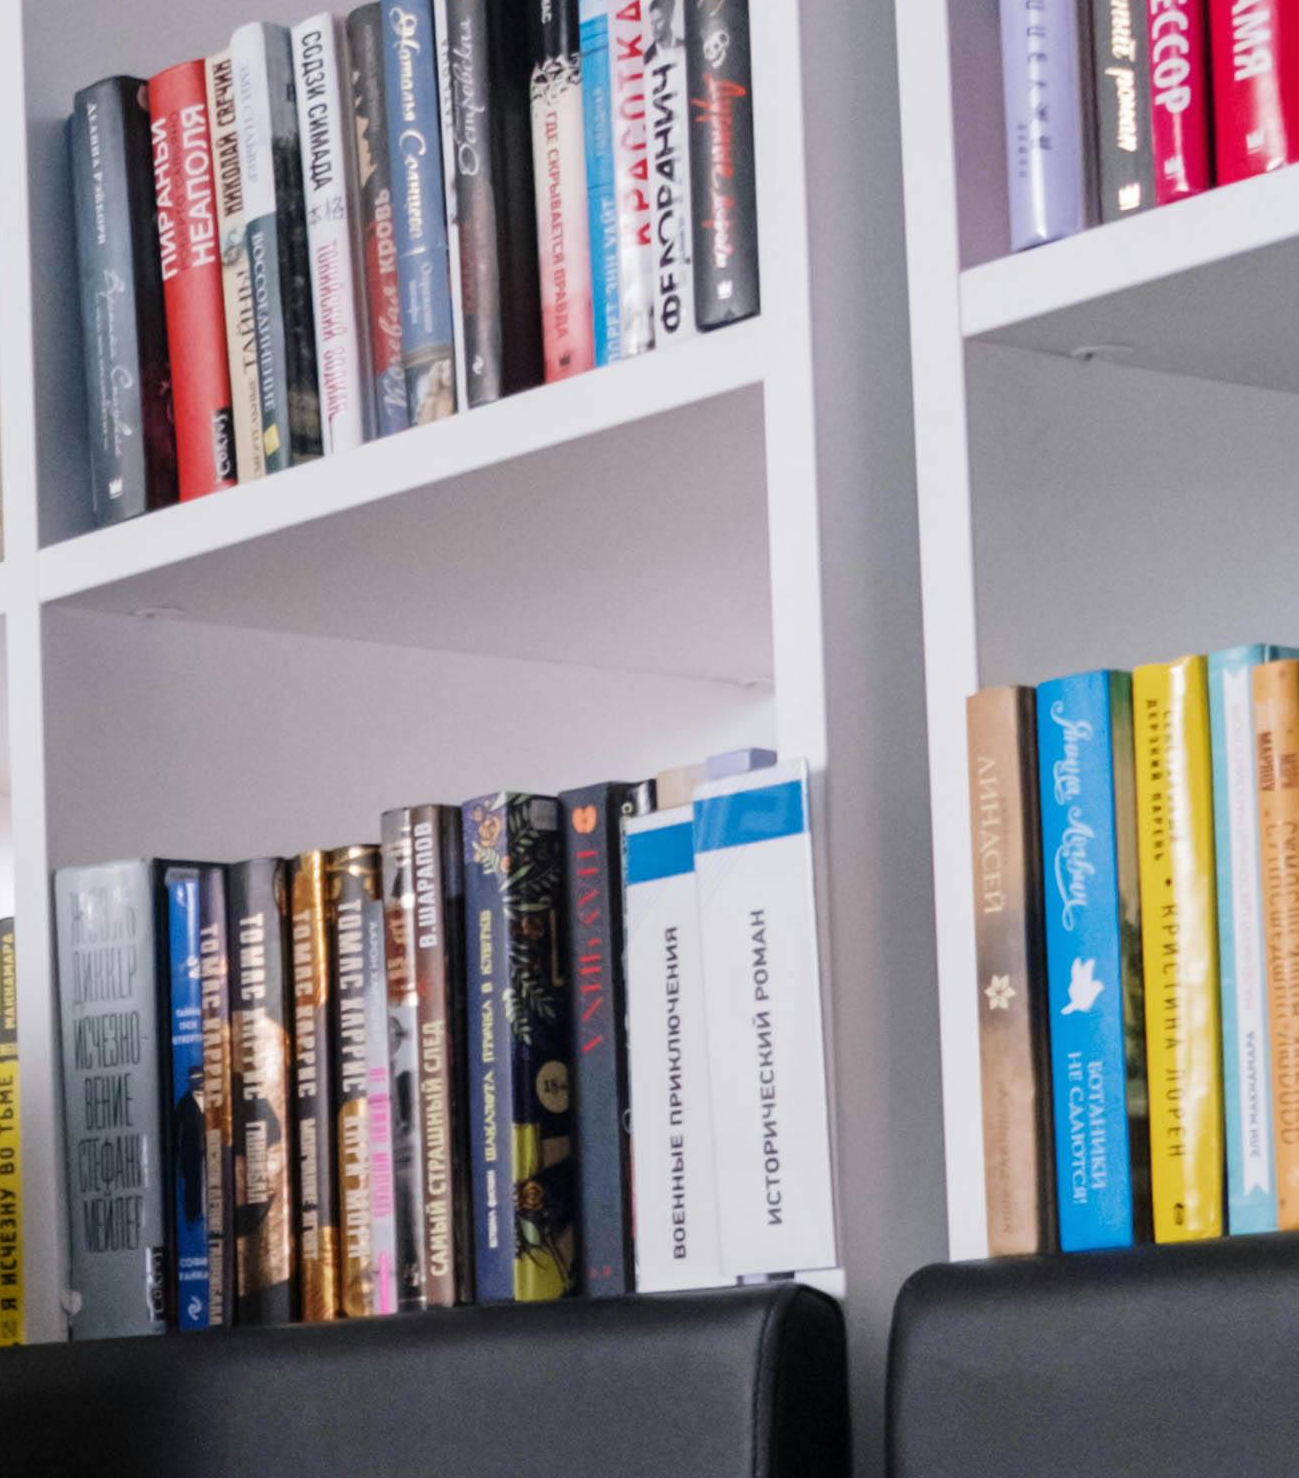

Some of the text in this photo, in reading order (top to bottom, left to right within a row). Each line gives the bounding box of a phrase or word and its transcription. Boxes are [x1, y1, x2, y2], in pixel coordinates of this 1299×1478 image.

[180, 104, 216, 267] НЕАПОЛЯ
[211, 57, 244, 216] НИКОЛАЙ СВЕЧИН
[301, 29, 335, 191] СОДЗИ СИМАДА
[150, 119, 181, 281] ПИРАНЬИ
[546, 111, 571, 338] ГДЕ СКРЫВАЕТСЯ ПРАВДА
[413, 821, 437, 948] В.ШАРАПОВ
[979, 753, 1007, 914] ЛИНДСЕЙ
[1, 932, 15, 1030] МАКНАМАРА
[199, 922, 224, 1108] ТОМАС ХАРРИС
[239, 912, 264, 1004] ТОМАС
[294, 908, 320, 1097] ТОМАС ХАРРИС
[337, 899, 368, 1093] ТОМАС ХАРРИС
[1158, 902, 1189, 1159] КРИСТИНА ЛОРЕН
[72, 1010, 149, 1072] ИСЧЕЗНО-
[83, 1072, 133, 1129] ВЕНИЕ
[664, 926, 688, 1261] ВОЕННЫЕ ПРИКЛЮЧЕНИЯ
[749, 909, 784, 1226] ИСТОРИЧЕСКИЙ РОМАН
[0, 1147, 16, 1177] ВО
[422, 1021, 452, 1277] САМЫЙ СТРАШНЫЙ СЛЕД
[1066, 1052, 1092, 1208] НЕ СДАЮТСЯ!
[1085, 1060, 1108, 1191] БОТАНИКИ
[0, 1295, 15, 1312] Я
[82, 1196, 145, 1255] МЕЙЛЕР
